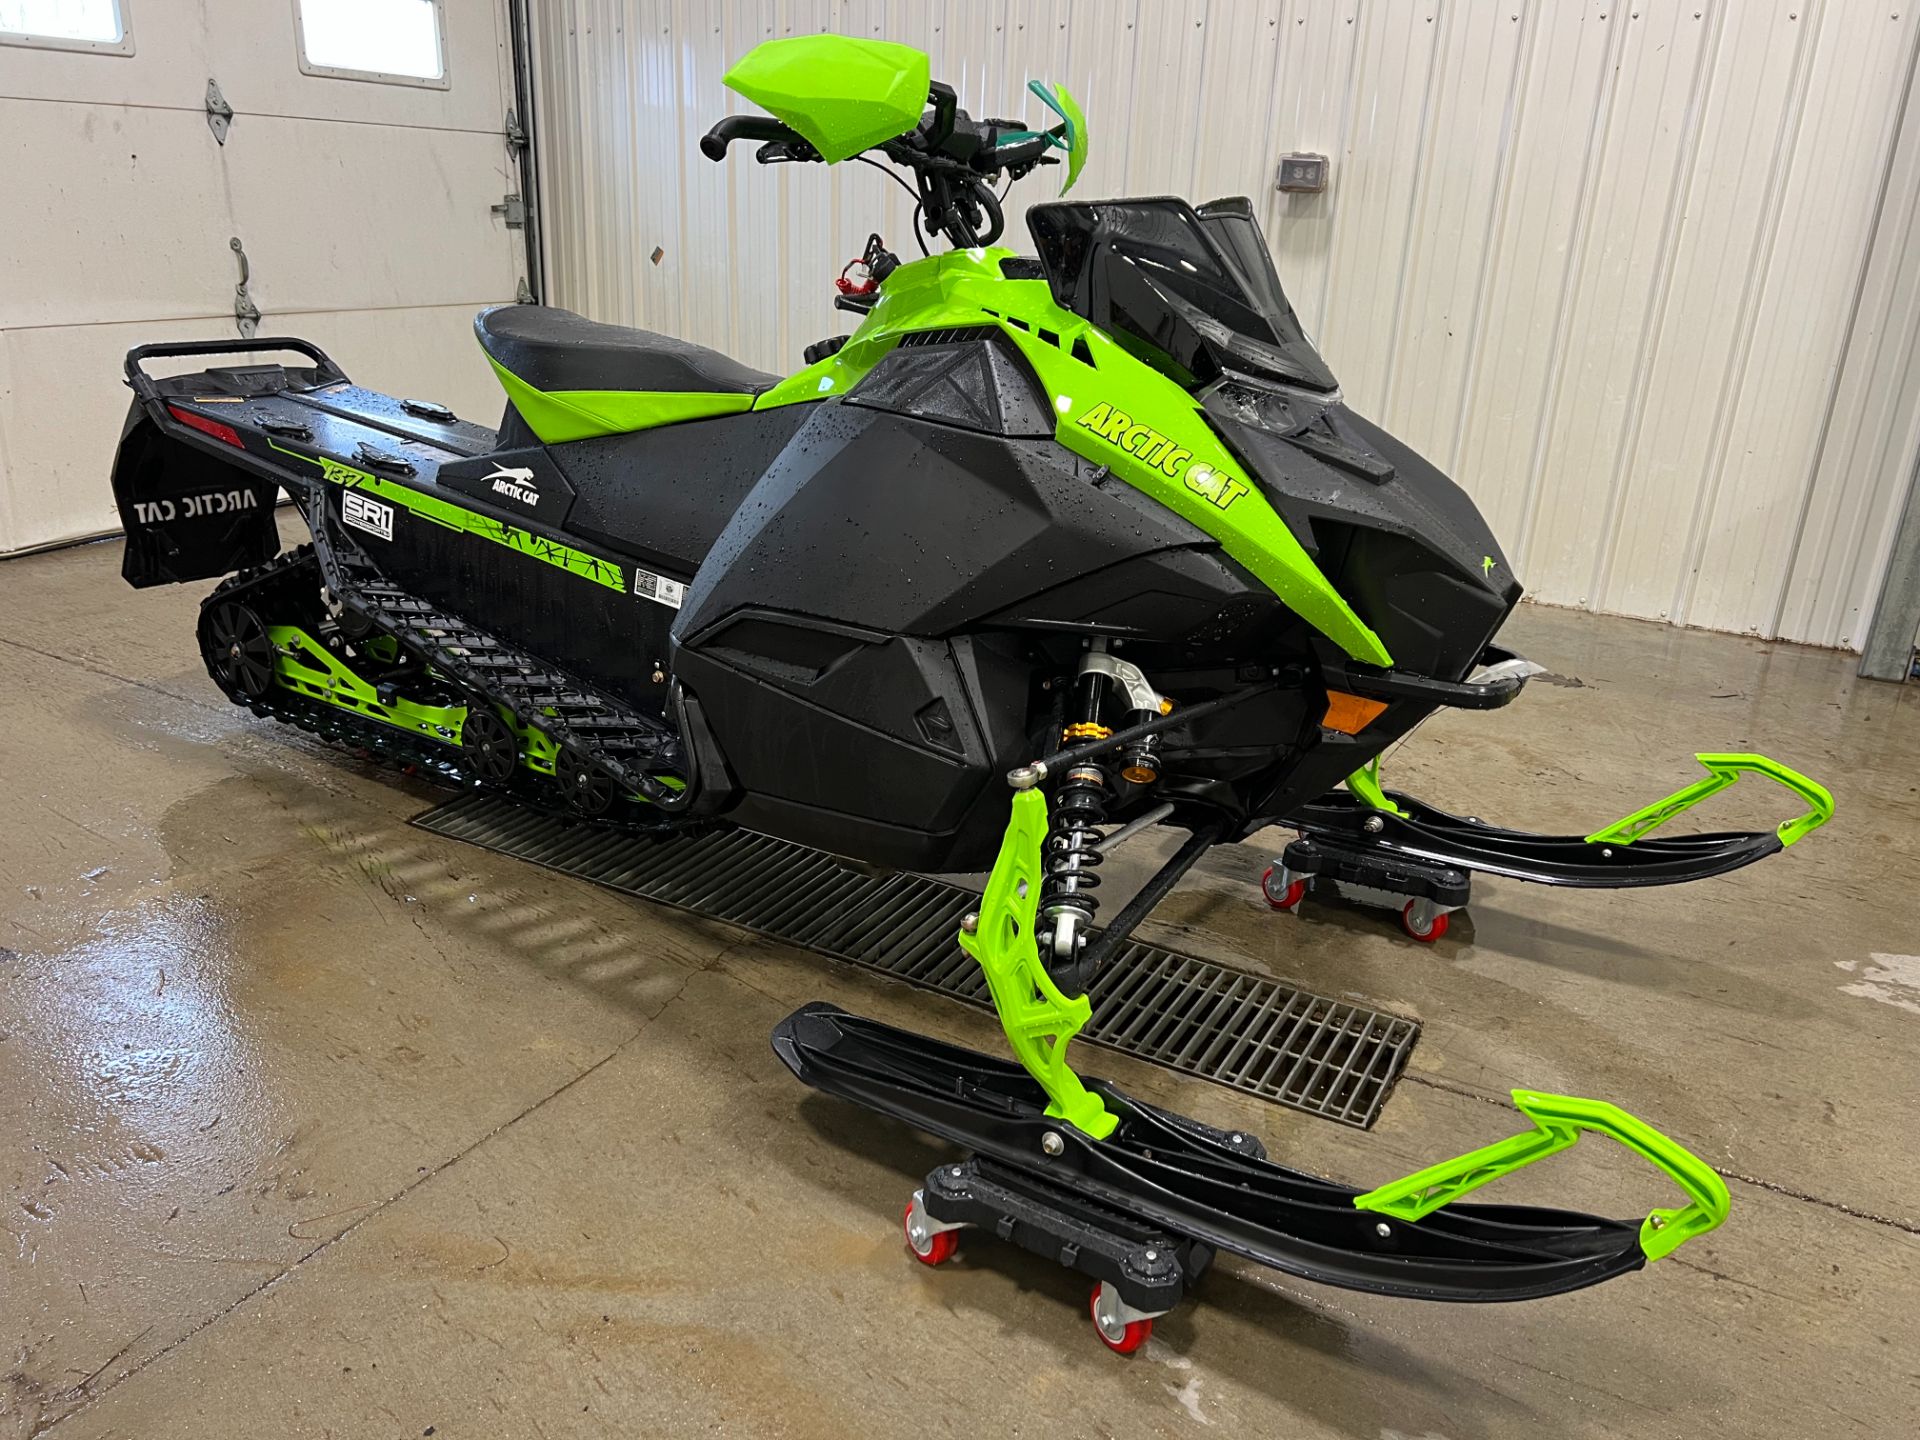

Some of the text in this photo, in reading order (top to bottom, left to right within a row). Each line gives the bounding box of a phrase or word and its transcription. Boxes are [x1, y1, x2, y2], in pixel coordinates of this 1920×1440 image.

[1076, 401, 1249, 510] ARCTIC CAT
[492, 479, 540, 507] ARCTIC CAT
[346, 494, 391, 531] SR1
